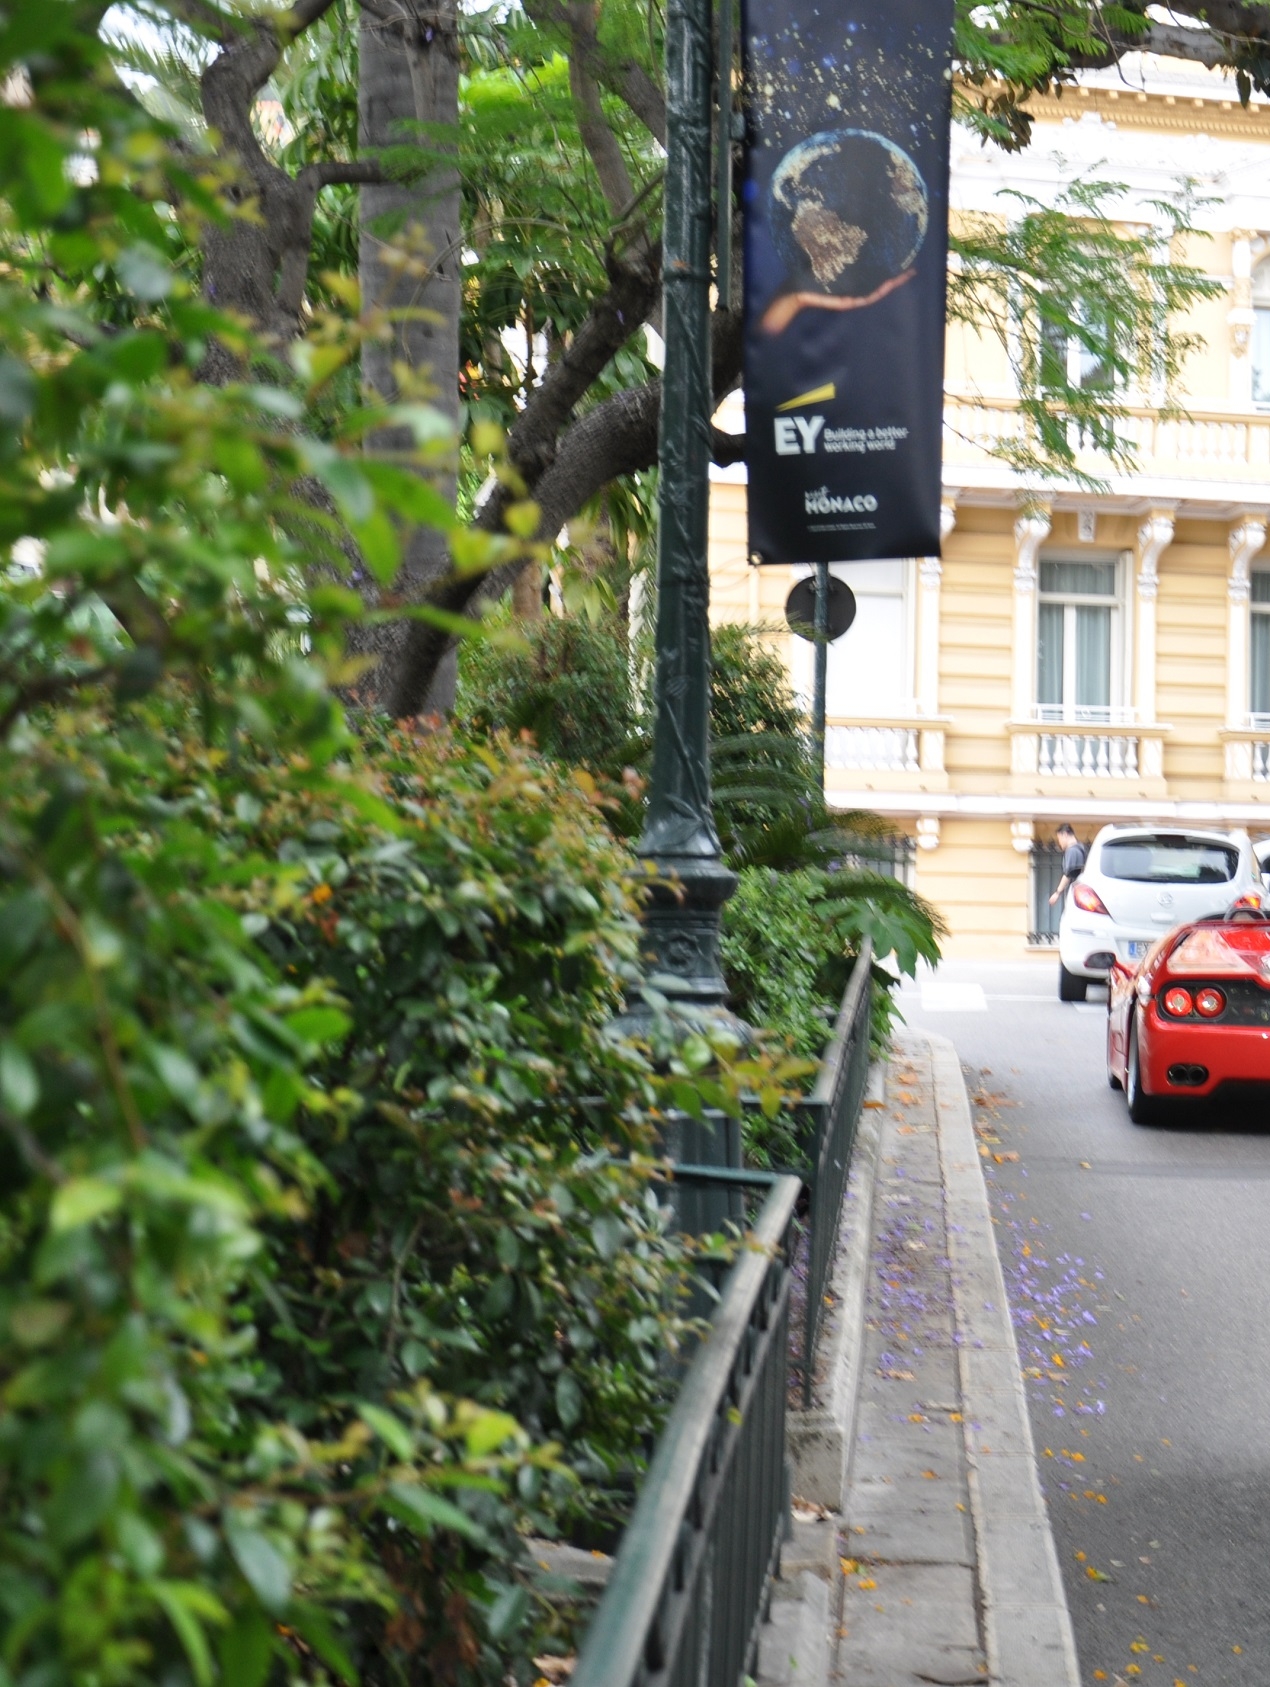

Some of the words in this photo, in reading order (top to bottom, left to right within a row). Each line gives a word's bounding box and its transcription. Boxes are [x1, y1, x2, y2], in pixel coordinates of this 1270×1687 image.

[774, 415, 826, 456] EY
[824, 427, 866, 441] Building
[875, 425, 909, 440] better
[824, 440, 866, 454] working
[867, 439, 897, 451] world
[805, 494, 878, 515] MONACO
